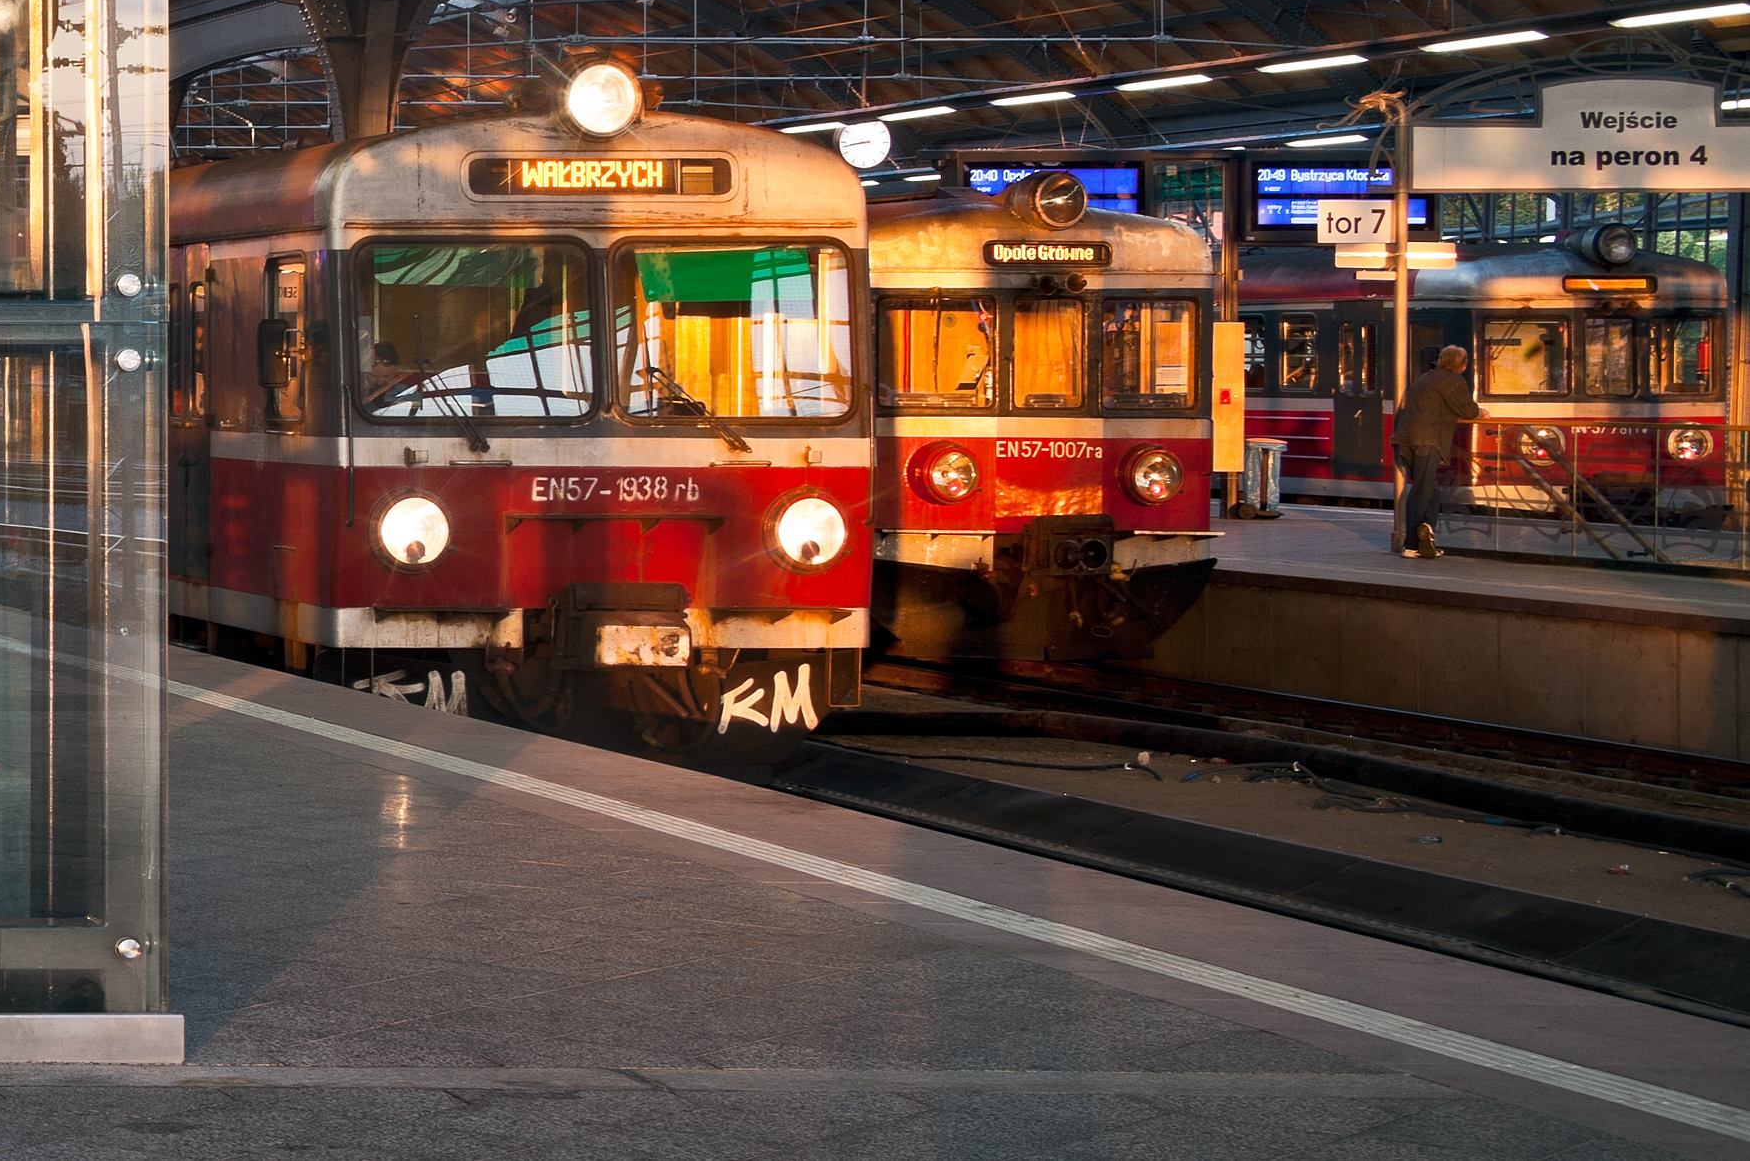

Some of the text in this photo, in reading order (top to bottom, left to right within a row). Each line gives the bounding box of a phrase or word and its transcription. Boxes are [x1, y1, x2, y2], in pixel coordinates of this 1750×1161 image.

[1580, 111, 1678, 134] Wejście
[1551, 145, 1708, 171] na peron 4
[522, 161, 663, 188] WAŁBRZYCH
[970, 169, 998, 182] 20:40
[1257, 169, 1286, 181] 20:49
[1291, 169, 1344, 182] Bystrzyca
[1326, 209, 1386, 234] tor 7
[993, 244, 1037, 262] Opole
